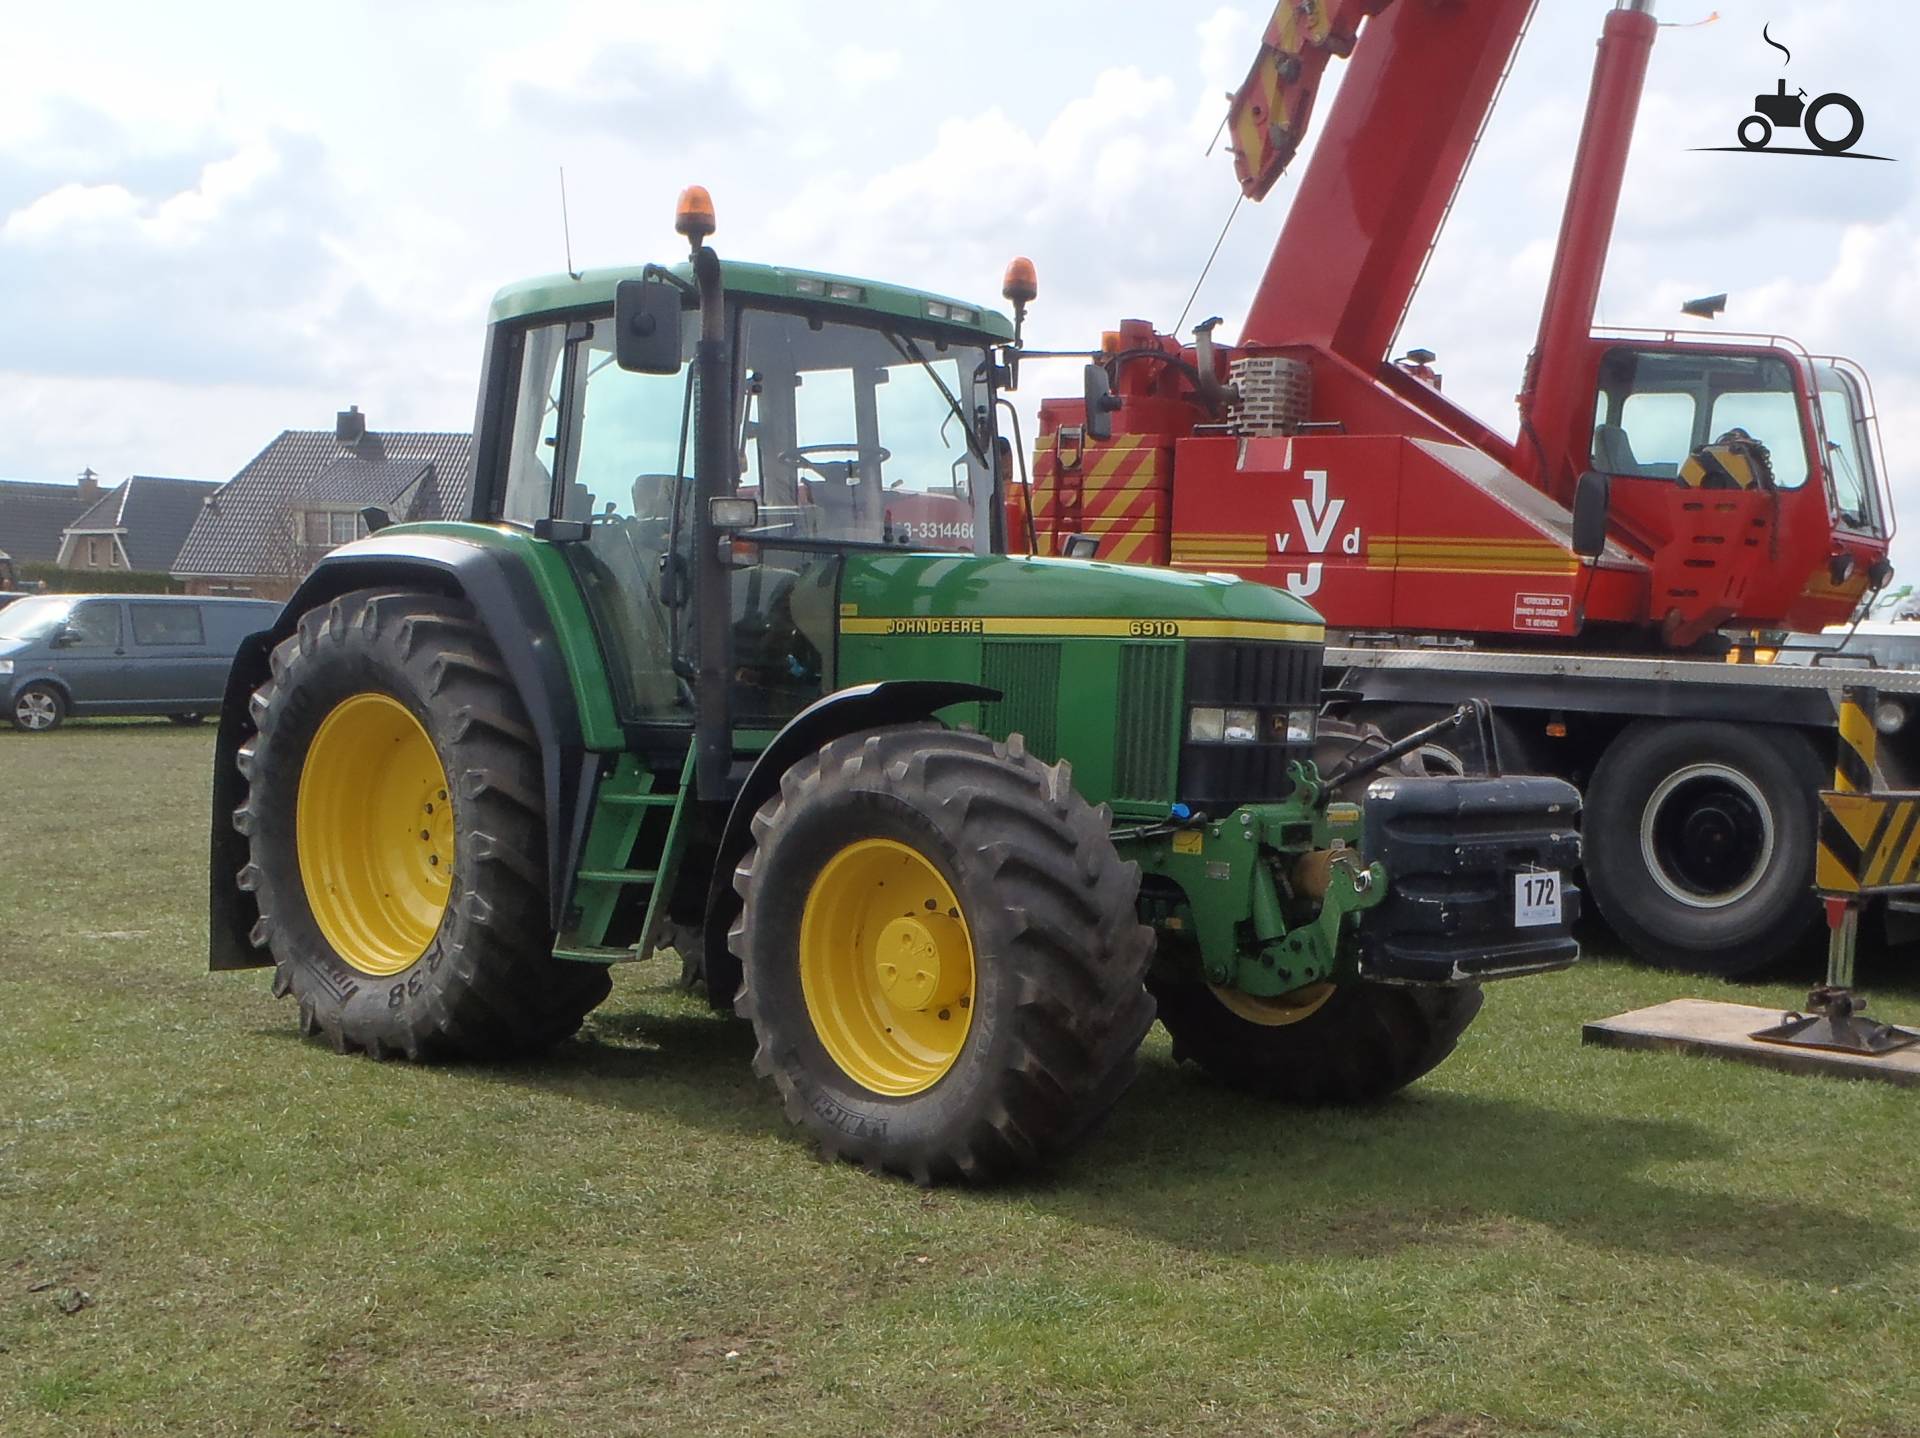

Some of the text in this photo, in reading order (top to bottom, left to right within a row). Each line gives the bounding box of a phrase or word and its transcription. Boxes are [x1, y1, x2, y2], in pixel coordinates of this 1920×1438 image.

[896, 522, 975, 539] 3-331446
[887, 620, 982, 633] JOHN DEERE
[1130, 621, 1177, 636] 6910
[1524, 878, 1555, 907] 172
